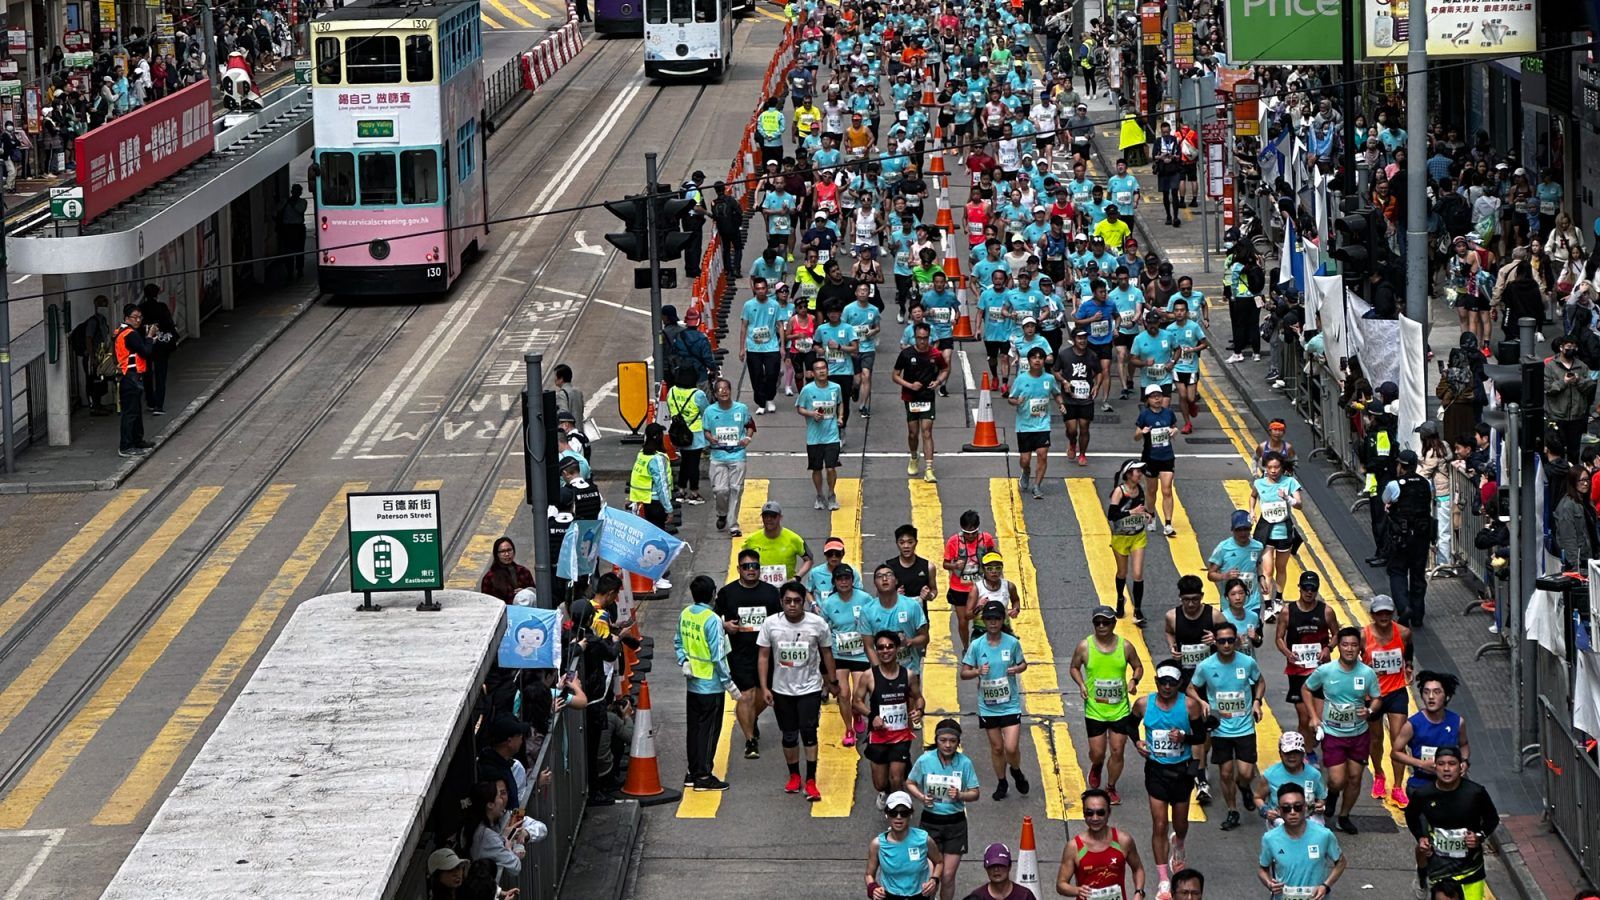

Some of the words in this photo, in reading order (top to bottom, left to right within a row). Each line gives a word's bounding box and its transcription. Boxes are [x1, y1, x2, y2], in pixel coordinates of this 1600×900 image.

[317, 22, 331, 32] 130
[413, 19, 428, 29] 130
[338, 94, 372, 105] 錫自己
[376, 92, 411, 104] 做篩查
[331, 216, 430, 226] www.cervicalscreening.gov.hk
[427, 267, 442, 278] 130
[407, 394, 520, 414] ANE
[381, 420, 515, 441] RAM
[382, 499, 431, 511] 百德新街
[412, 533, 433, 543] 53E
[421, 569, 434, 577] 東行
[763, 573, 784, 583] 9188
[740, 615, 766, 625] G4527
[838, 639, 864, 651] H4172
[780, 651, 807, 662] G1611
[1374, 658, 1401, 669] B2115
[983, 686, 1009, 698] H6938
[1095, 688, 1122, 698] G7335
[1218, 700, 1245, 711] G0715
[883, 713, 907, 725] A0774
[1328, 709, 1354, 721] H2281
[1436, 840, 1467, 851] H1799
